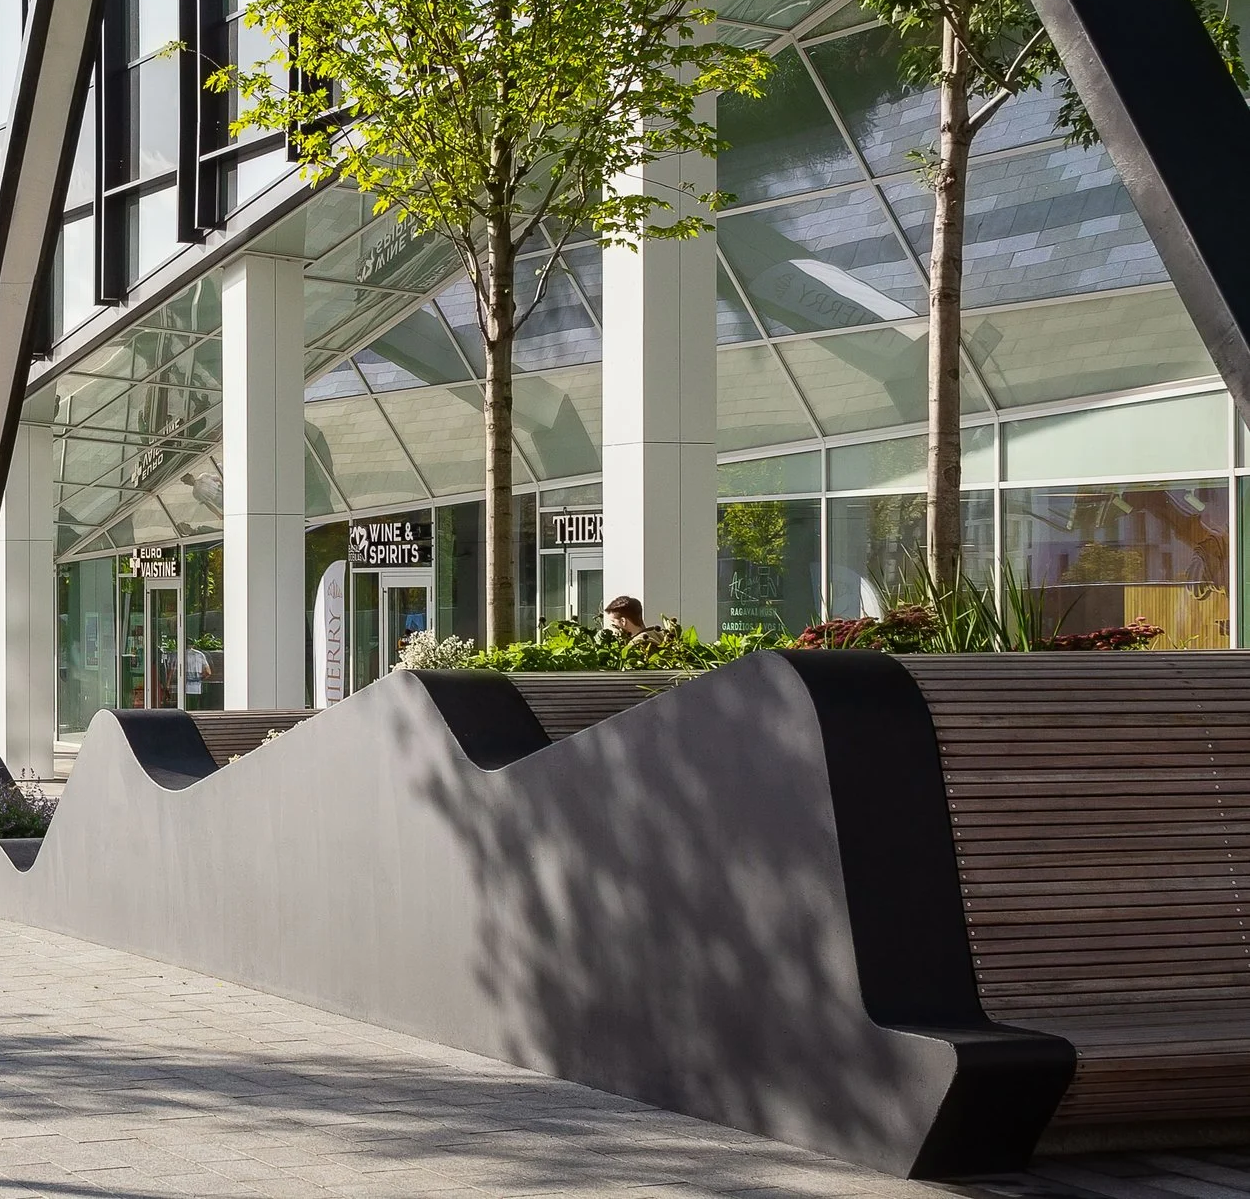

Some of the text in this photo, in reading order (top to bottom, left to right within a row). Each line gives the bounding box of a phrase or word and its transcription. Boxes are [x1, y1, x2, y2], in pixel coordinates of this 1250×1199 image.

[369, 522, 414, 543] WINE &
[140, 547, 162, 559] EURO
[369, 543, 419, 564] SPIRITS
[140, 557, 177, 578] VAISTINĖ
[327, 609, 342, 704] IERRY
